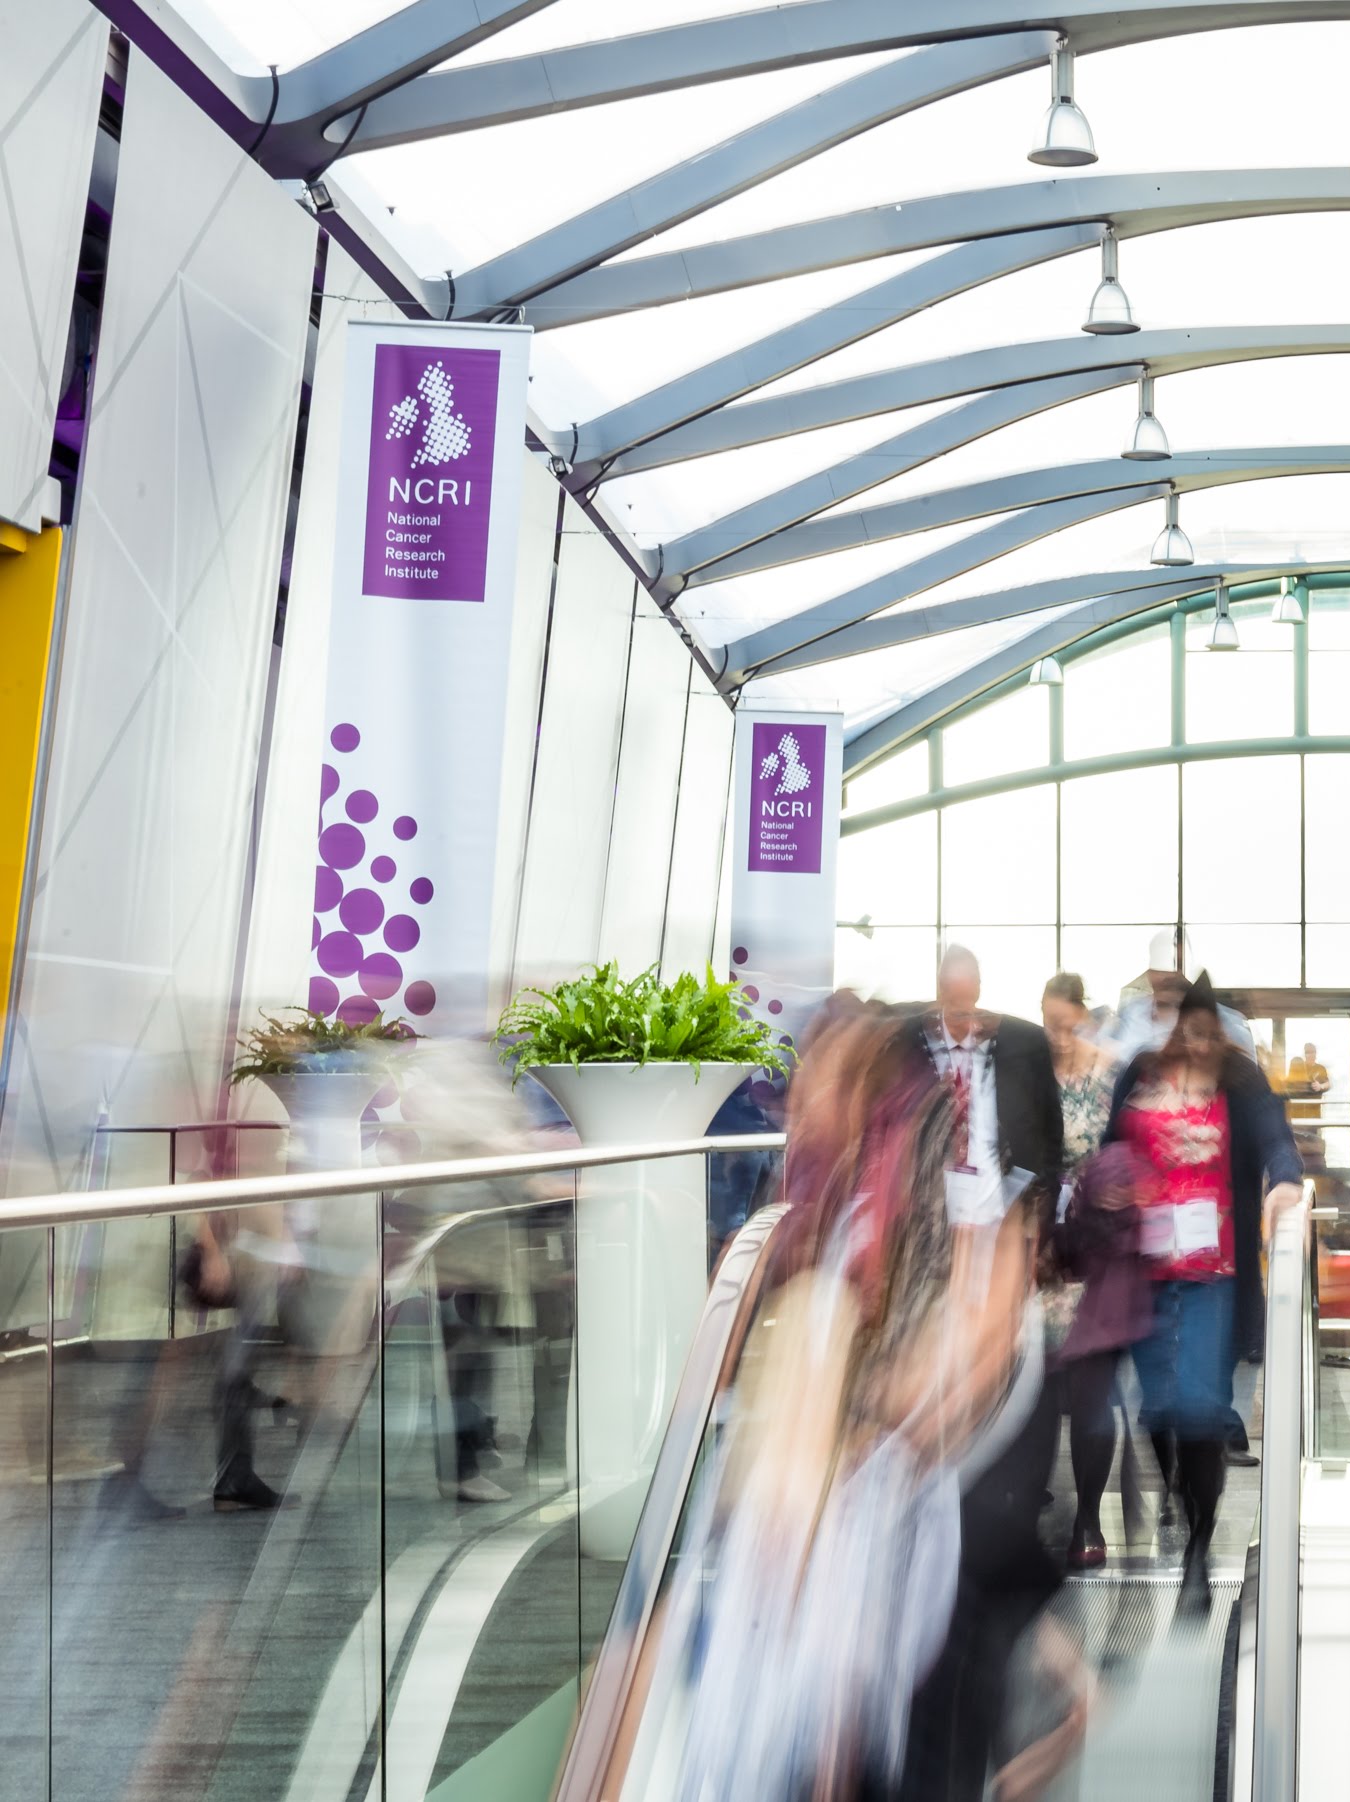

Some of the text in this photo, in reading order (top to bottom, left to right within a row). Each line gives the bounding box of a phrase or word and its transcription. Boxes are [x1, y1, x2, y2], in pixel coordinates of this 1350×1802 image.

[389, 476, 471, 506] NCRI
[387, 511, 441, 526] National
[385, 529, 432, 544] Cancer
[385, 546, 446, 562] Research
[384, 564, 439, 579] Institute
[761, 800, 812, 818] NCRI
[761, 820, 794, 830] National
[760, 831, 788, 840] Cancer
[760, 841, 798, 851] Research
[760, 852, 794, 861] Institute
